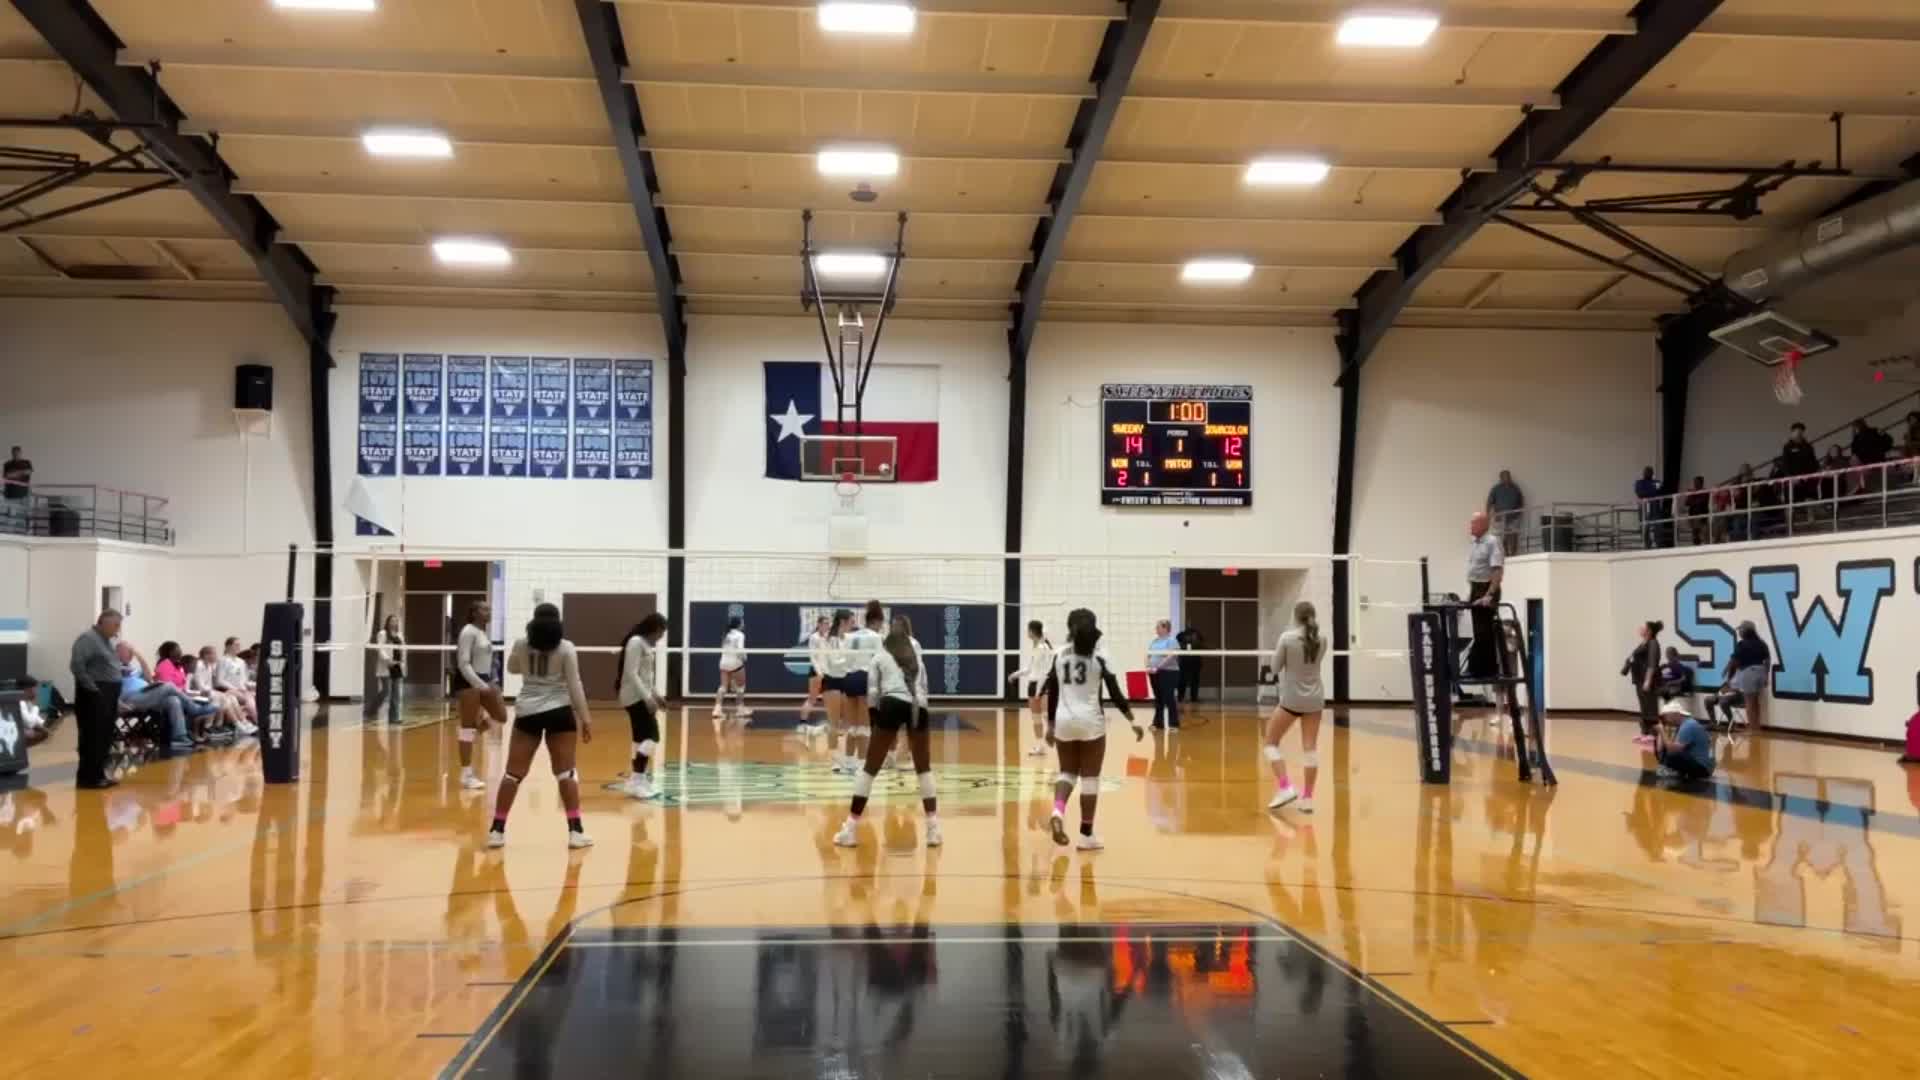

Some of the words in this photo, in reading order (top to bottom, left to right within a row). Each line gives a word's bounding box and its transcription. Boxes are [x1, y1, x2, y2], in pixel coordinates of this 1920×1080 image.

[1169, 402, 1205, 421] 1:00
[1125, 436, 1143, 454] 14
[1177, 439, 1183, 452] 1
[1225, 437, 1242, 456] 12
[1117, 471, 1128, 486] 2
[1144, 472, 1149, 485] 1
[1211, 473, 1216, 487] 1
[1674, 557, 1920, 705] SW
[1063, 661, 1087, 685] 13
[266, 640, 287, 749] SWEENY
